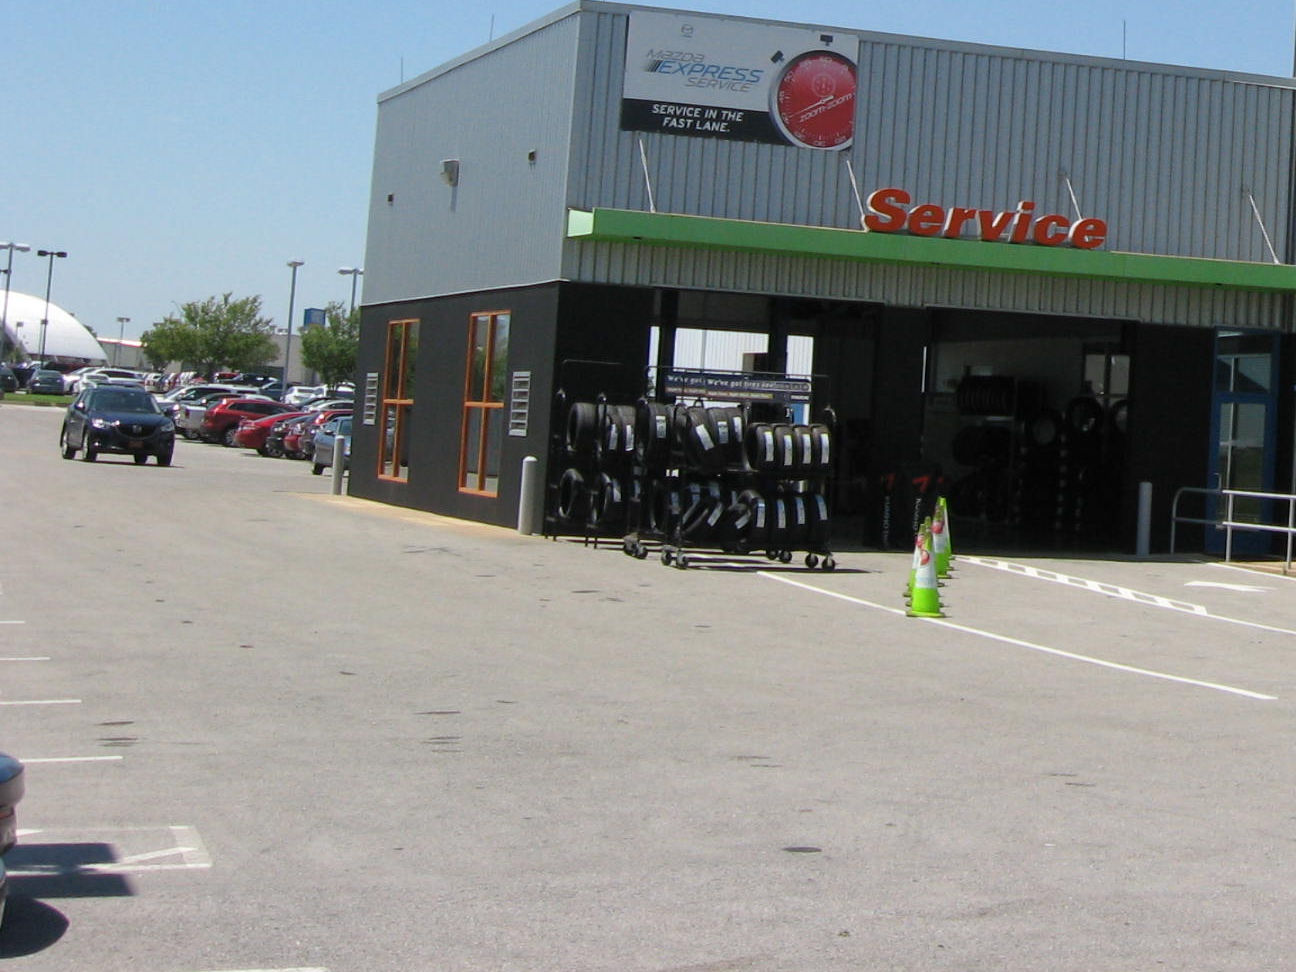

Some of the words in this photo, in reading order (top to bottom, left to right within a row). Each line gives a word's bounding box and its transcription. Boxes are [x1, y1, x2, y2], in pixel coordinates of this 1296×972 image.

[657, 60, 764, 83] EXPRESS
[685, 77, 752, 92] SERVICE
[652, 104, 701, 118] SERVICE
[705, 109, 717, 119] IN
[721, 111, 744, 122] THE
[662, 117, 693, 128] FAST
[696, 121, 730, 132] LANE.
[864, 188, 1108, 249] Service
